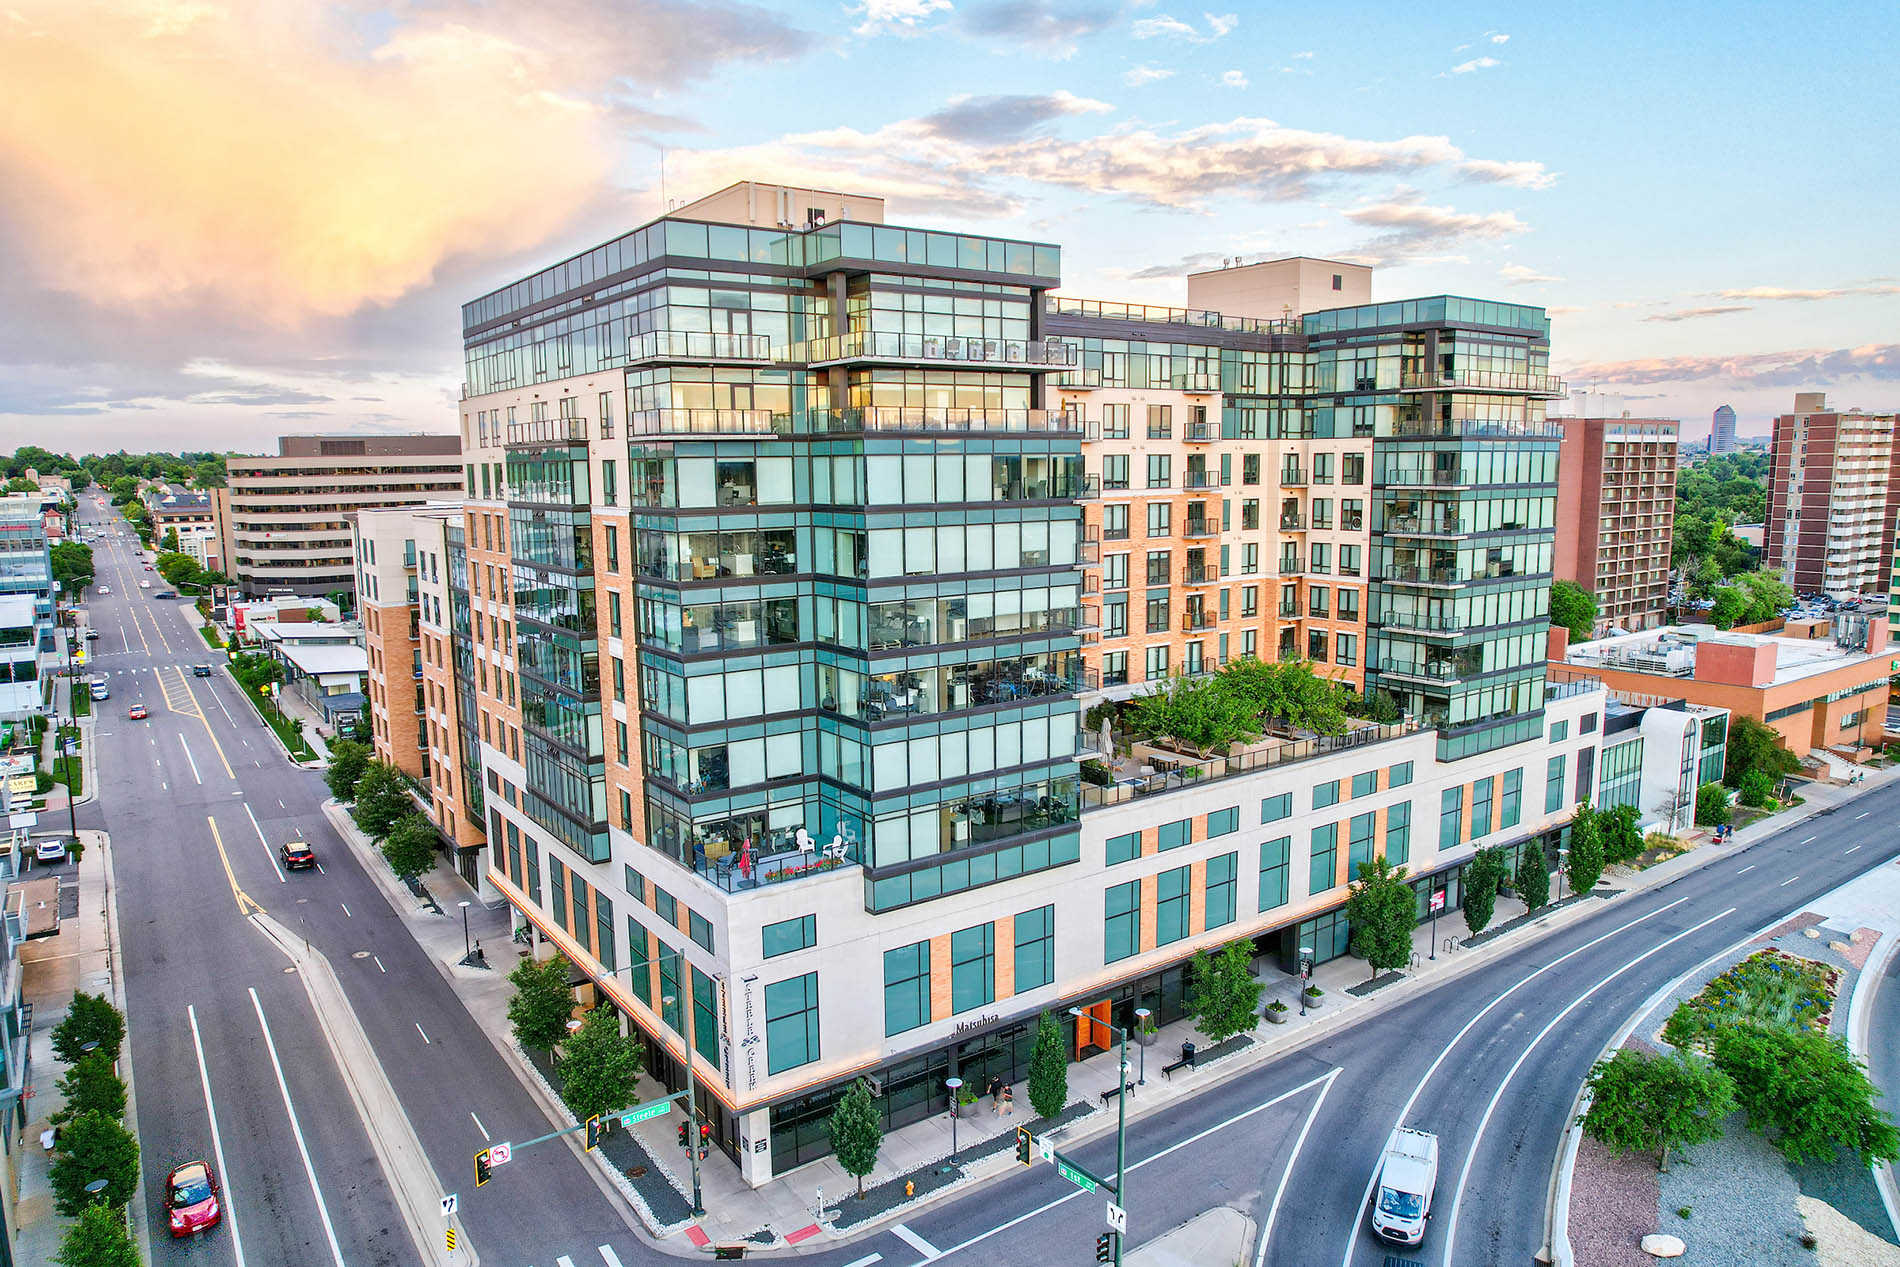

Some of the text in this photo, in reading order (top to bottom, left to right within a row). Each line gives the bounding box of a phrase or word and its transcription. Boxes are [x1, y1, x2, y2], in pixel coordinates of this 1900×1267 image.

[955, 1014, 1000, 1034] Matsuhisa
[632, 1109, 656, 1122] Steele
[1070, 1171, 1081, 1184] 1st
